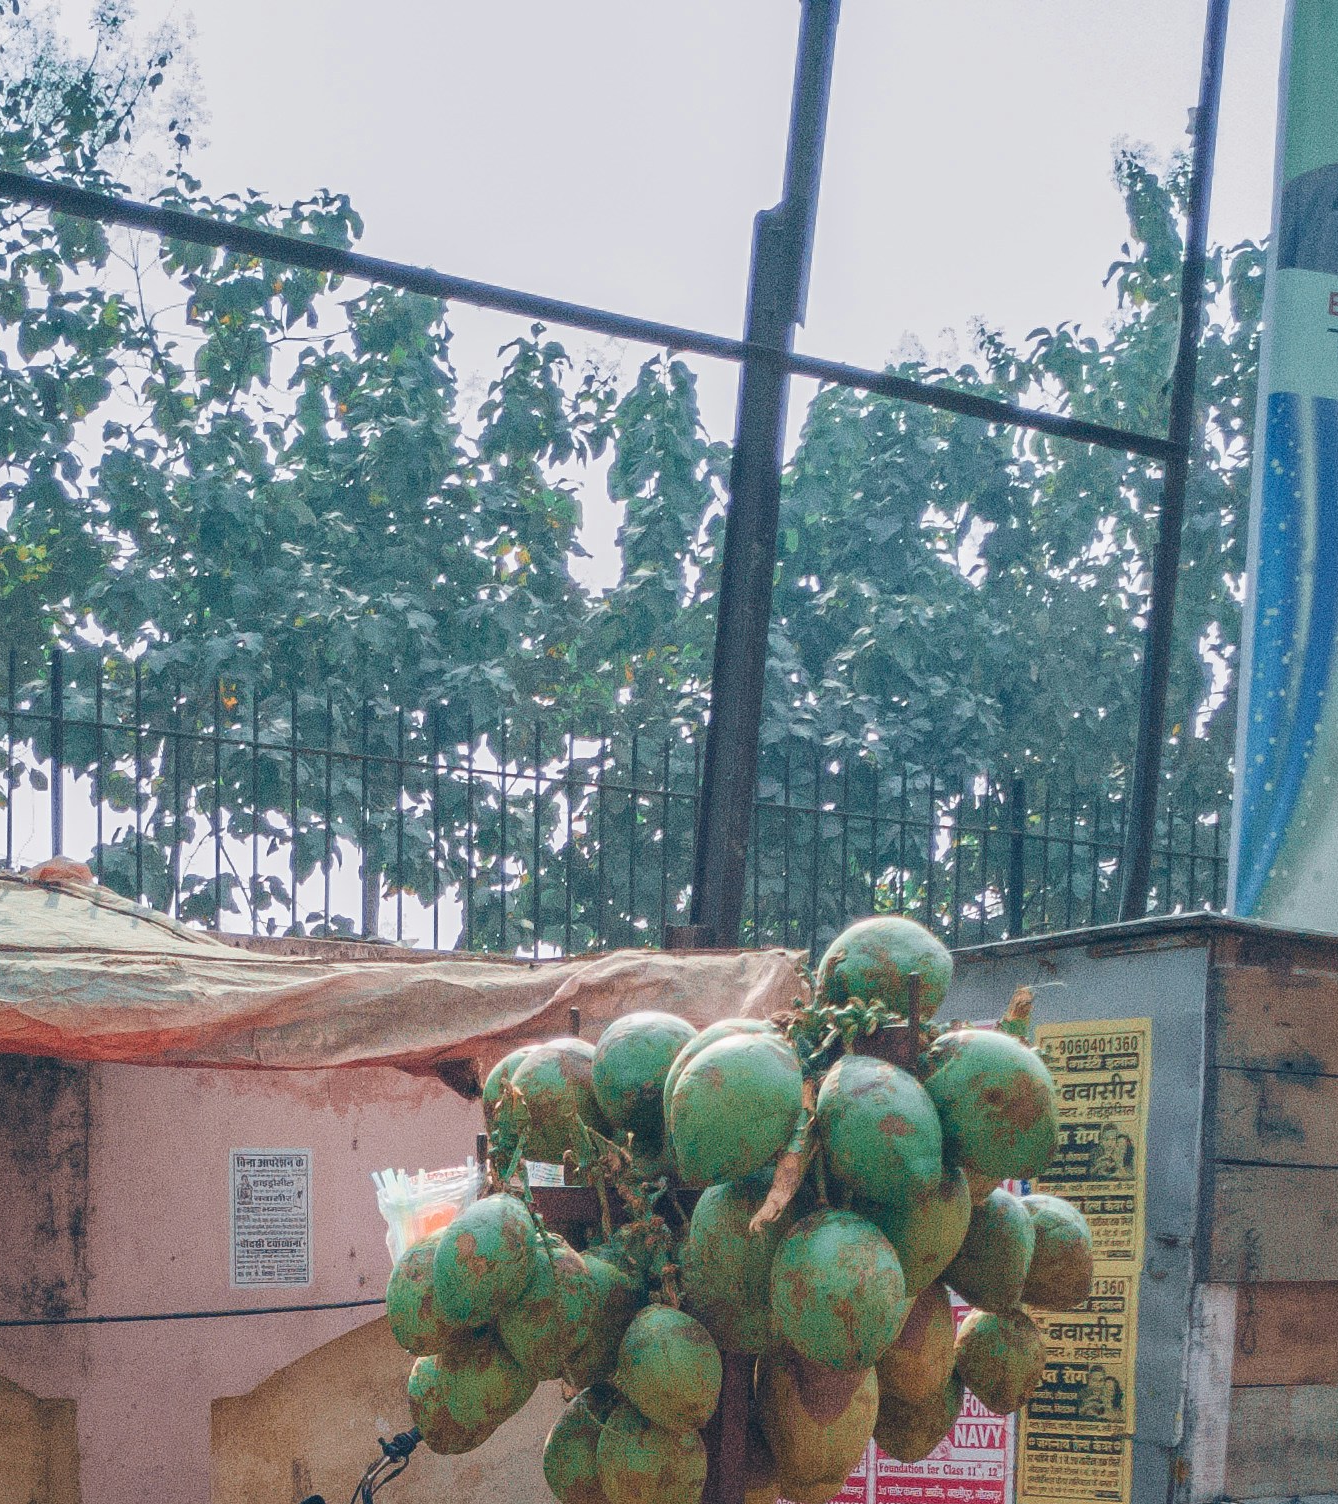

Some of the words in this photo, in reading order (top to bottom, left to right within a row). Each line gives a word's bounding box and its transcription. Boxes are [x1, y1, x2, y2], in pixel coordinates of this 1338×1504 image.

[1062, 1073, 1138, 1101] बवासीर
[1049, 1316, 1123, 1342] बवासीर
[1062, 1365, 1088, 1385] रोग
[954, 1424, 1002, 1448] NAVY
[879, 1462, 923, 1475] Foundation
[927, 1464, 939, 1475] for
[943, 1464, 963, 1476] Class
